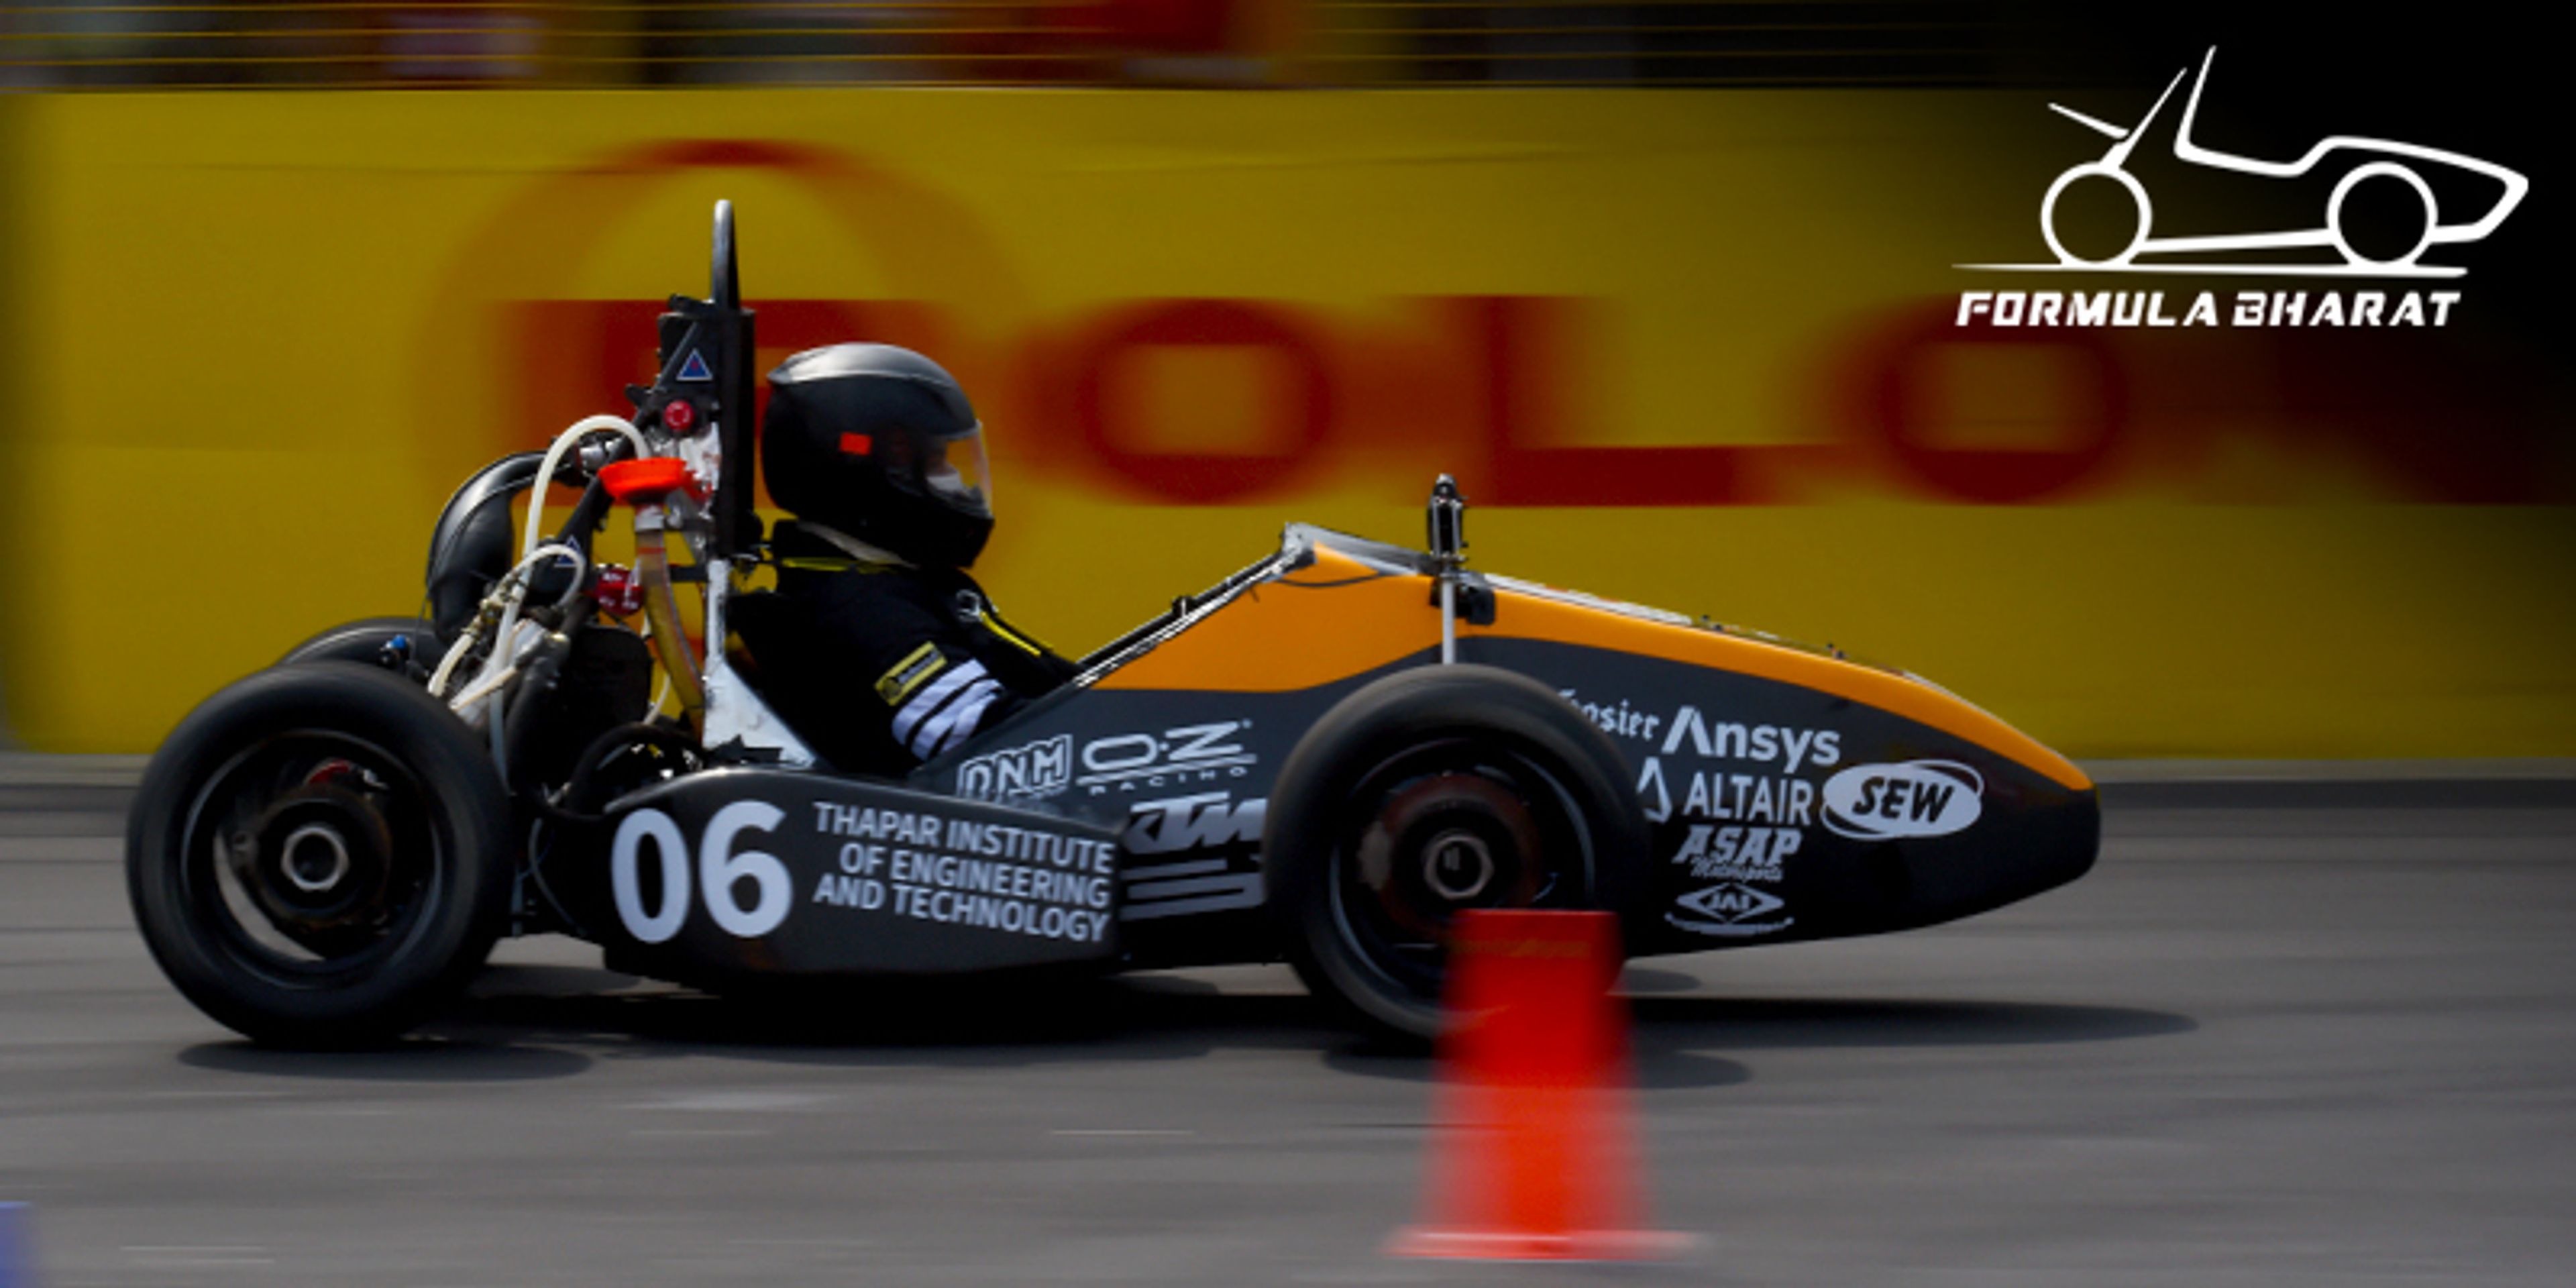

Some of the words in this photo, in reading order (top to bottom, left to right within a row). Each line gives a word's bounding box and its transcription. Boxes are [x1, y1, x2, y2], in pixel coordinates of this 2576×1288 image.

[1661, 706, 1841, 773] Ansys
[1089, 765, 1248, 796] RACING
[1682, 771, 1813, 826] ALTAIR
[1852, 775, 1955, 823] SEW
[812, 801, 941, 847] THAPAR
[946, 820, 1115, 874] INSTITUTE
[1124, 790, 1269, 855] KTM
[1672, 824, 1803, 865] ASAP
[609, 800, 793, 942] 06
[839, 842, 887, 875] OF
[890, 849, 1111, 909] ENGINEERING
[812, 873, 885, 910] AND
[892, 882, 1111, 943] TECHNOLOGY
